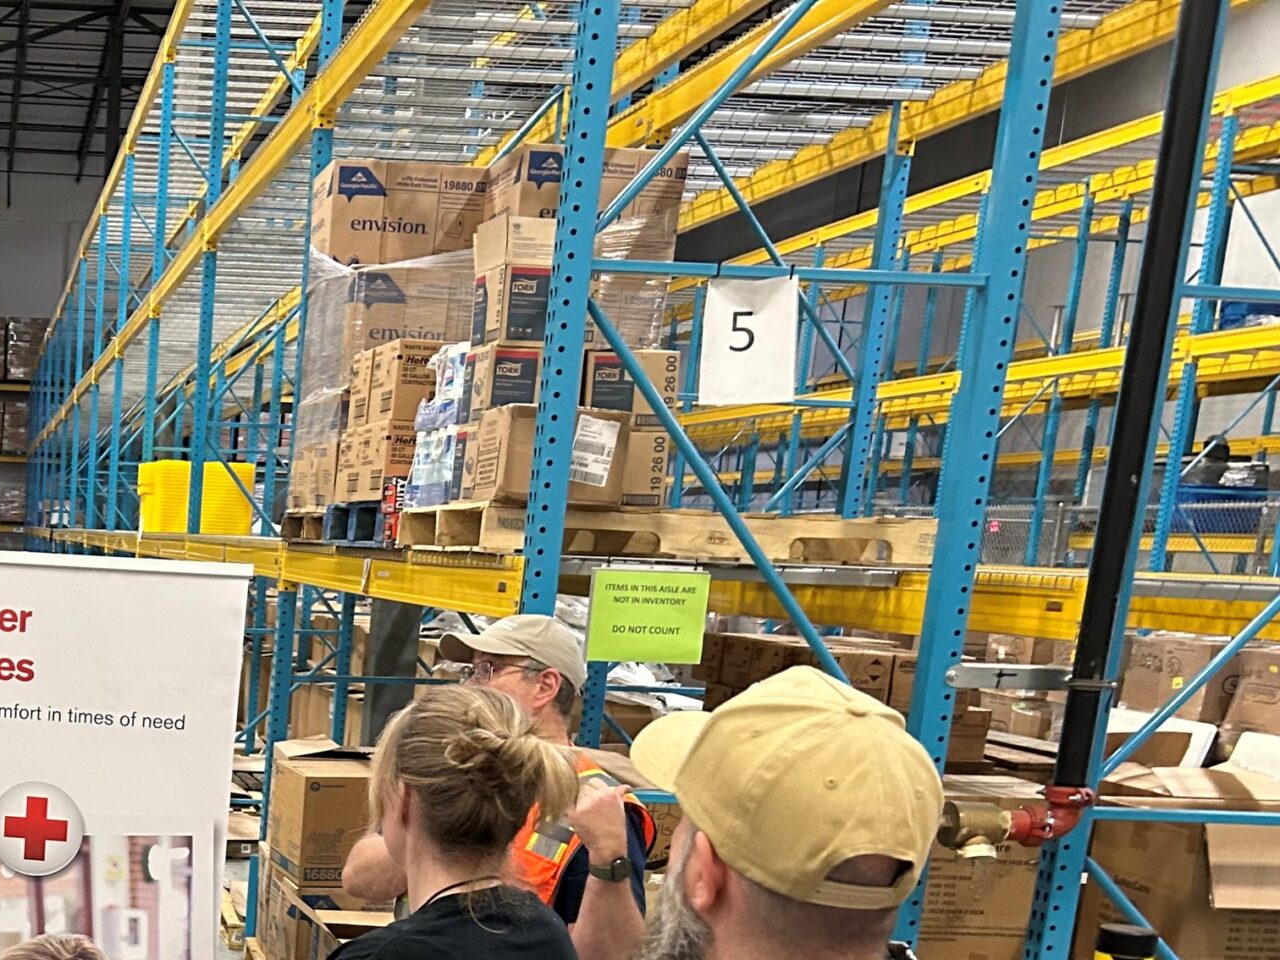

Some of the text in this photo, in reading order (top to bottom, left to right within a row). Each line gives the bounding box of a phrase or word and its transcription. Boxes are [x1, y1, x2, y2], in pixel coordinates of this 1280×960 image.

[443, 180, 474, 191] 19880
[350, 217, 427, 235] envision
[728, 310, 755, 352] 5
[406, 356, 431, 365] Heft
[666, 355, 678, 372] 00
[497, 365, 519, 374] TORK
[596, 371, 618, 380] TORK
[665, 376, 677, 393] 26
[395, 436, 418, 445] Heft
[650, 436, 666, 491] 19 26 00
[605, 583, 629, 592] ITEMS
[640, 585, 657, 593] THIS
[659, 585, 680, 593] AISLE
[681, 586, 697, 594] ARE
[631, 596, 640, 604] IN
[641, 597, 686, 606] INVENTORY
[612, 625, 680, 635] DO NOT COUNT
[47, 706, 61, 722] in
[68, 707, 113, 726] times
[119, 710, 138, 728] of
[142, 715, 186, 731] need
